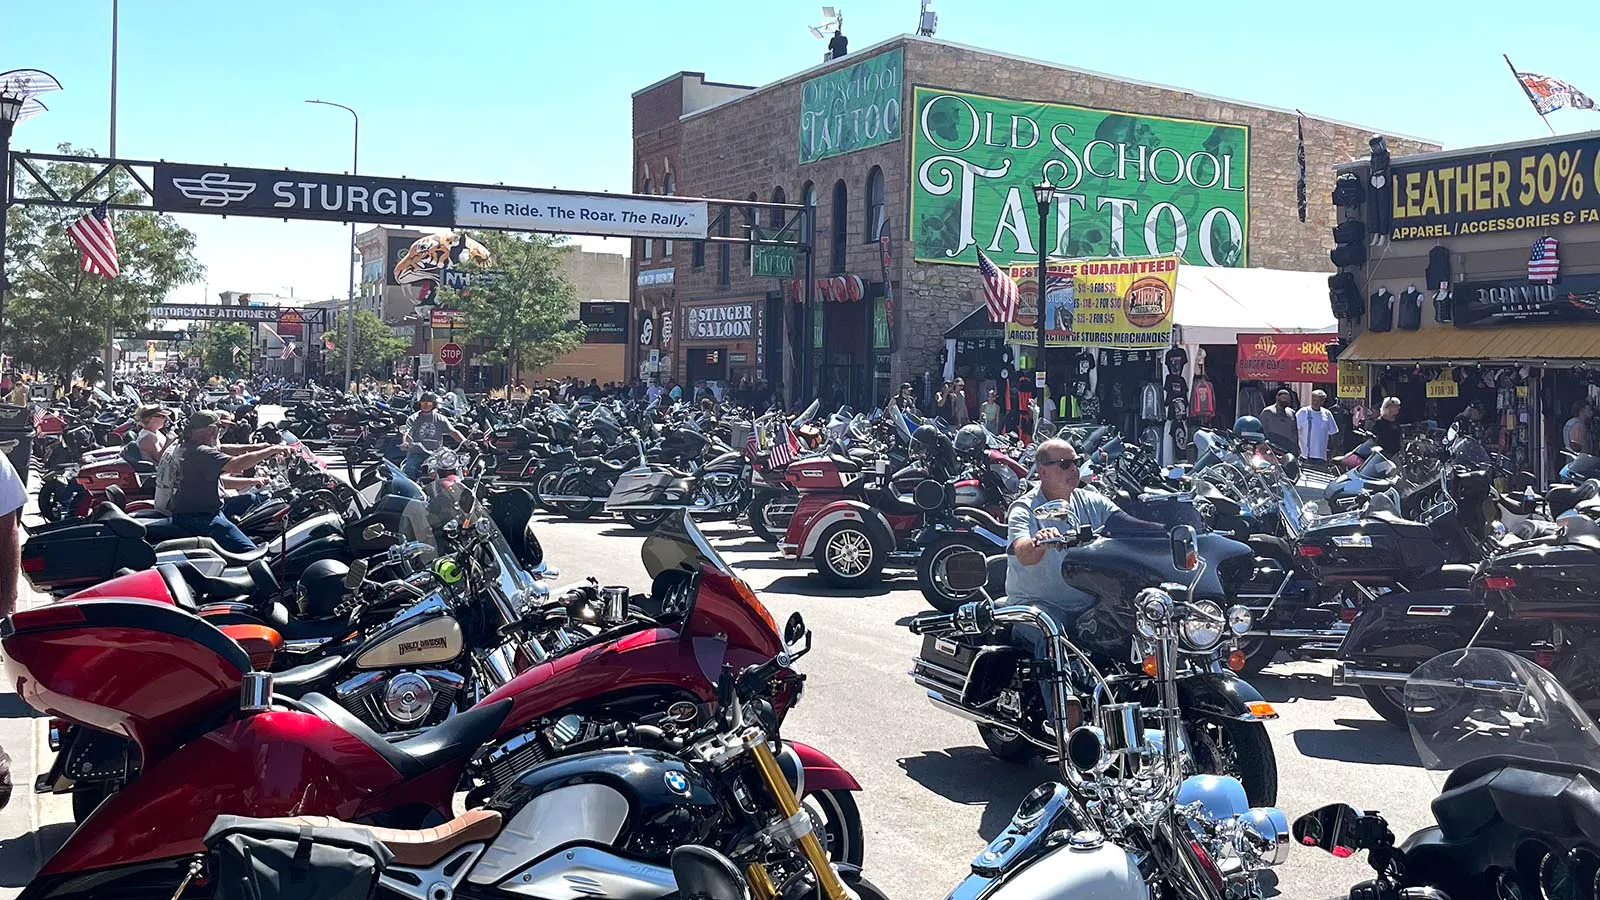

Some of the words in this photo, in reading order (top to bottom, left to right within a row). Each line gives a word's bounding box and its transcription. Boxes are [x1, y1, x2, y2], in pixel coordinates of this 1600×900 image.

[833, 67, 896, 114] SCHOOL
[802, 98, 899, 159] TATTOO
[919, 94, 1041, 153] OLD
[1041, 123, 1245, 193] SCHOOL
[1392, 160, 1511, 219] LEATHER
[1520, 150, 1584, 206] 50%
[470, 201, 500, 216] The
[504, 202, 543, 218] Ride.
[547, 206, 576, 221] The
[580, 208, 617, 223] Roar.
[621, 210, 647, 225] The
[918, 155, 1245, 267] TATTOO
[1392, 223, 1451, 239] APPAREL
[1461, 214, 1560, 234] ACCESSORIES
[1563, 211, 1576, 224] &
[754, 248, 794, 273] TATTOO
[1011, 266, 1039, 278] BEST
[1081, 260, 1176, 276] GUARANTEED
[149, 307, 216, 318] MOTORCYCLE
[217, 309, 277, 319] ATTORNEYS
[1100, 298, 1109, 308] FOR
[698, 305, 752, 322] STINGER
[1093, 313, 1104, 323] FOR
[698, 320, 751, 337] SALOON
[1036, 332, 1071, 342] ECTION
[1072, 332, 1081, 342] OF
[1081, 332, 1112, 343] STURGIS
[1114, 332, 1170, 343] MERCHANDISE
[441, 349, 461, 359] STOP
[398, 636, 448, 656] HARLEY-DAVIDSON
